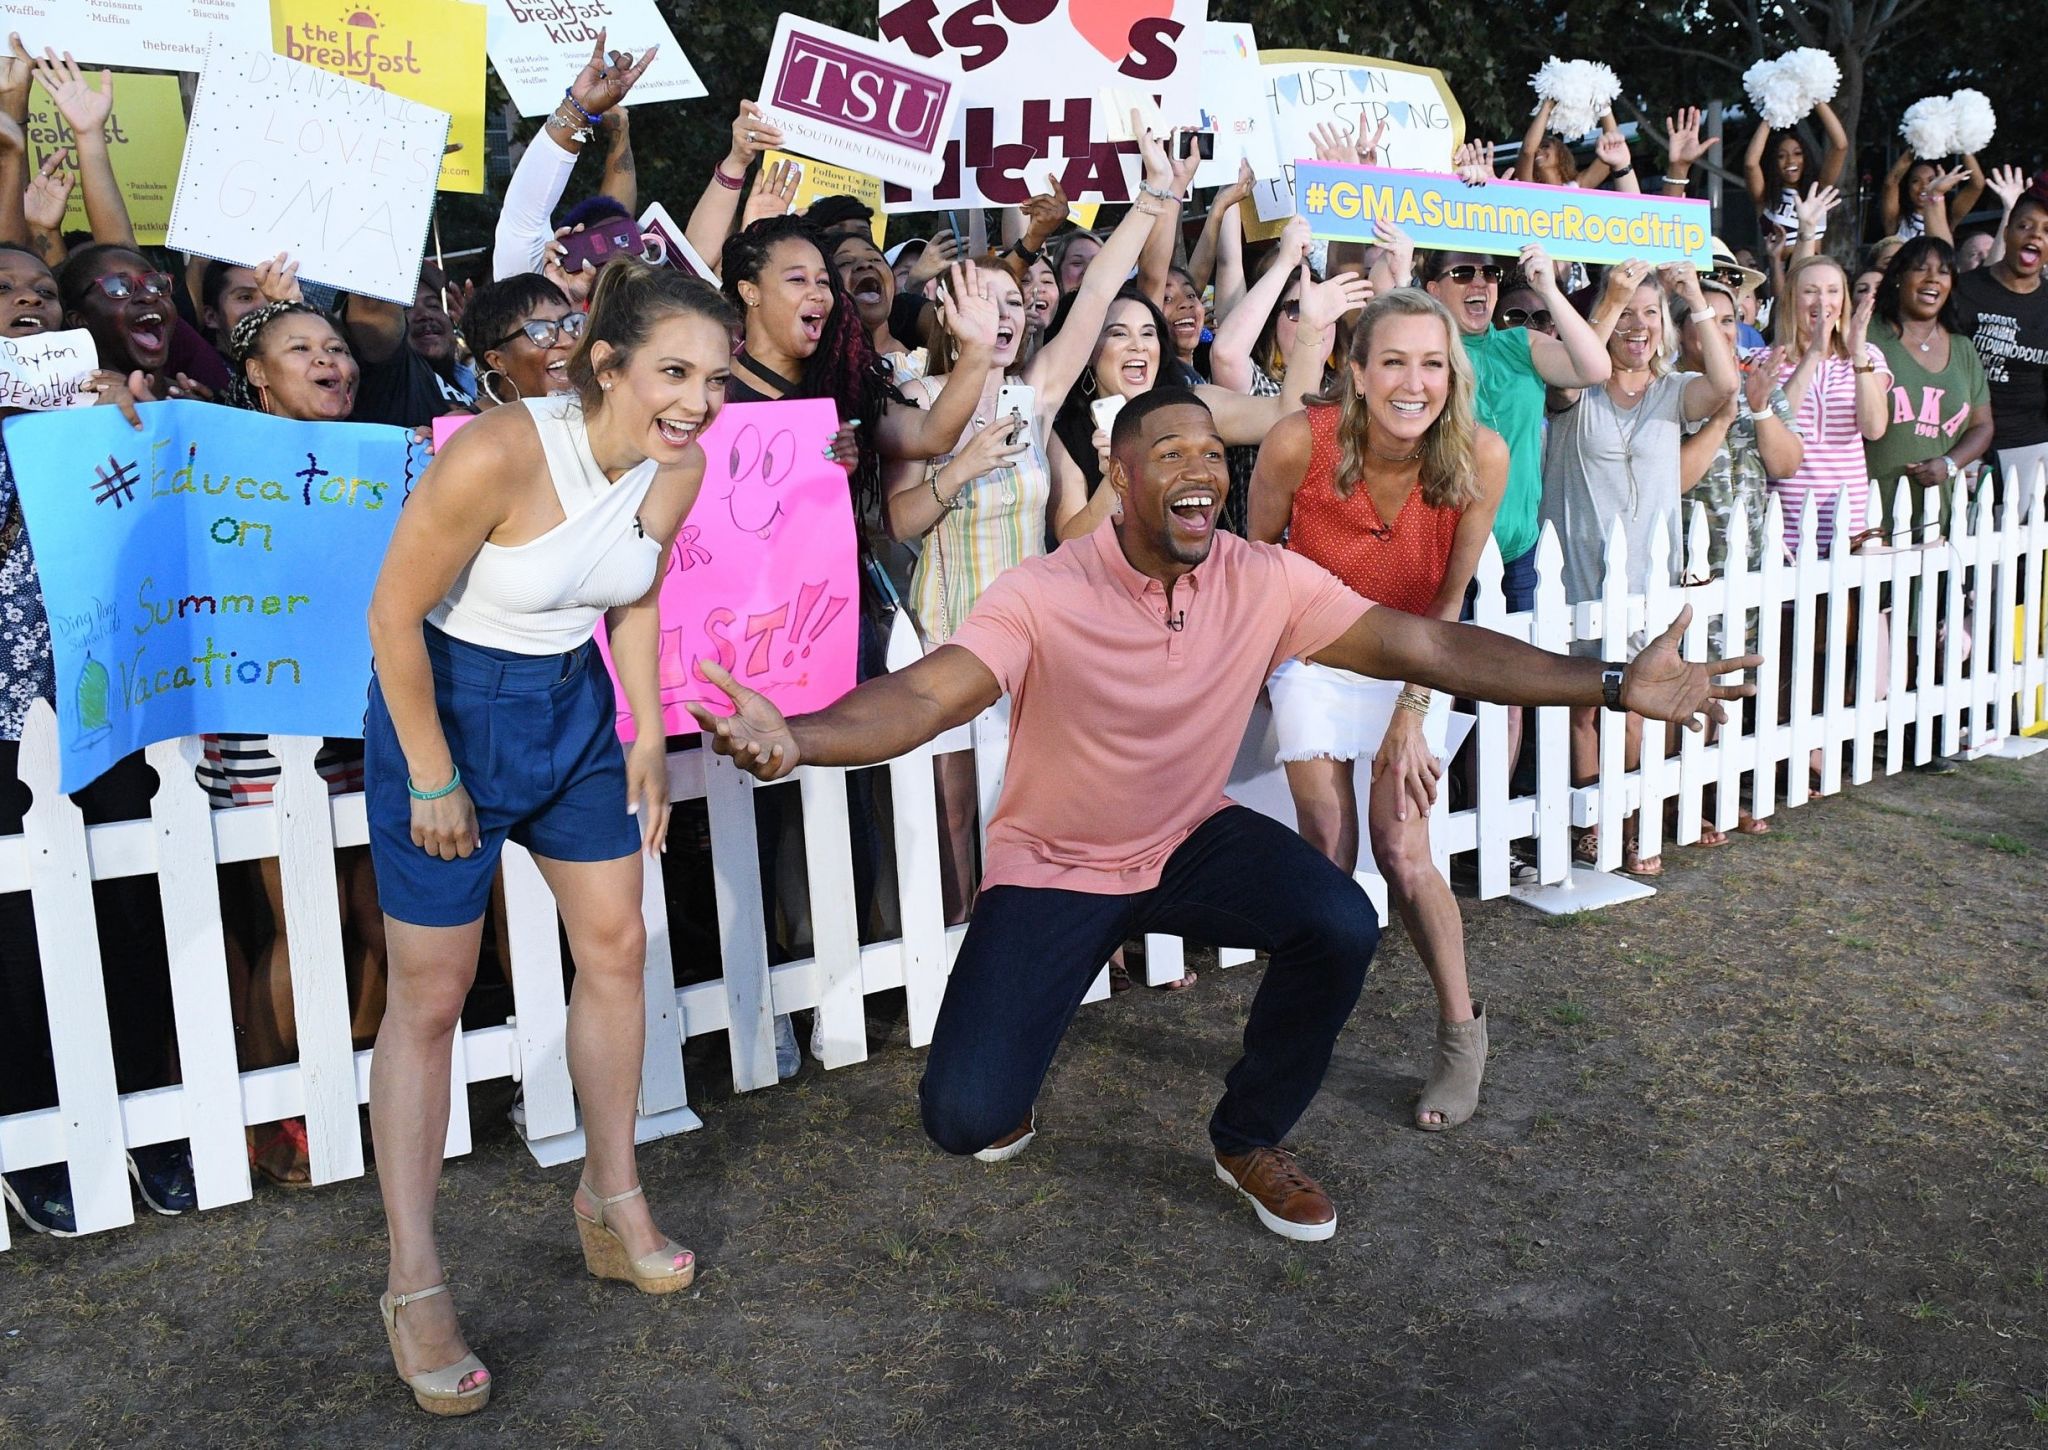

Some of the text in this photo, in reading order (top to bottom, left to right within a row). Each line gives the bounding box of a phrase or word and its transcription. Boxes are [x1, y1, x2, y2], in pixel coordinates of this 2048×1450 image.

[5, 4, 46, 17] Waffles
[92, 12, 131, 25] Muffins
[193, 8, 230, 21] Biscuits
[506, 0, 613, 26] breakfast
[544, 20, 599, 44] klub
[286, 25, 421, 76] breakfast
[302, 23, 338, 43] the
[248, 51, 417, 124] DYNAMIC
[794, 49, 940, 138] TSU
[264, 109, 431, 184] LOVES
[813, 166, 880, 190] Follow Us For
[813, 177, 876, 199] Great Flavor!
[218, 158, 403, 275] GMA
[1306, 180, 1706, 257] #GMASummerRoadtrip
[1892, 385, 1971, 438] AKA
[1914, 422, 1940, 439] 1908
[90, 438, 389, 511] #Educators
[210, 516, 272, 552] on
[133, 576, 311, 636] Summer
[118, 636, 302, 713] Vacation
